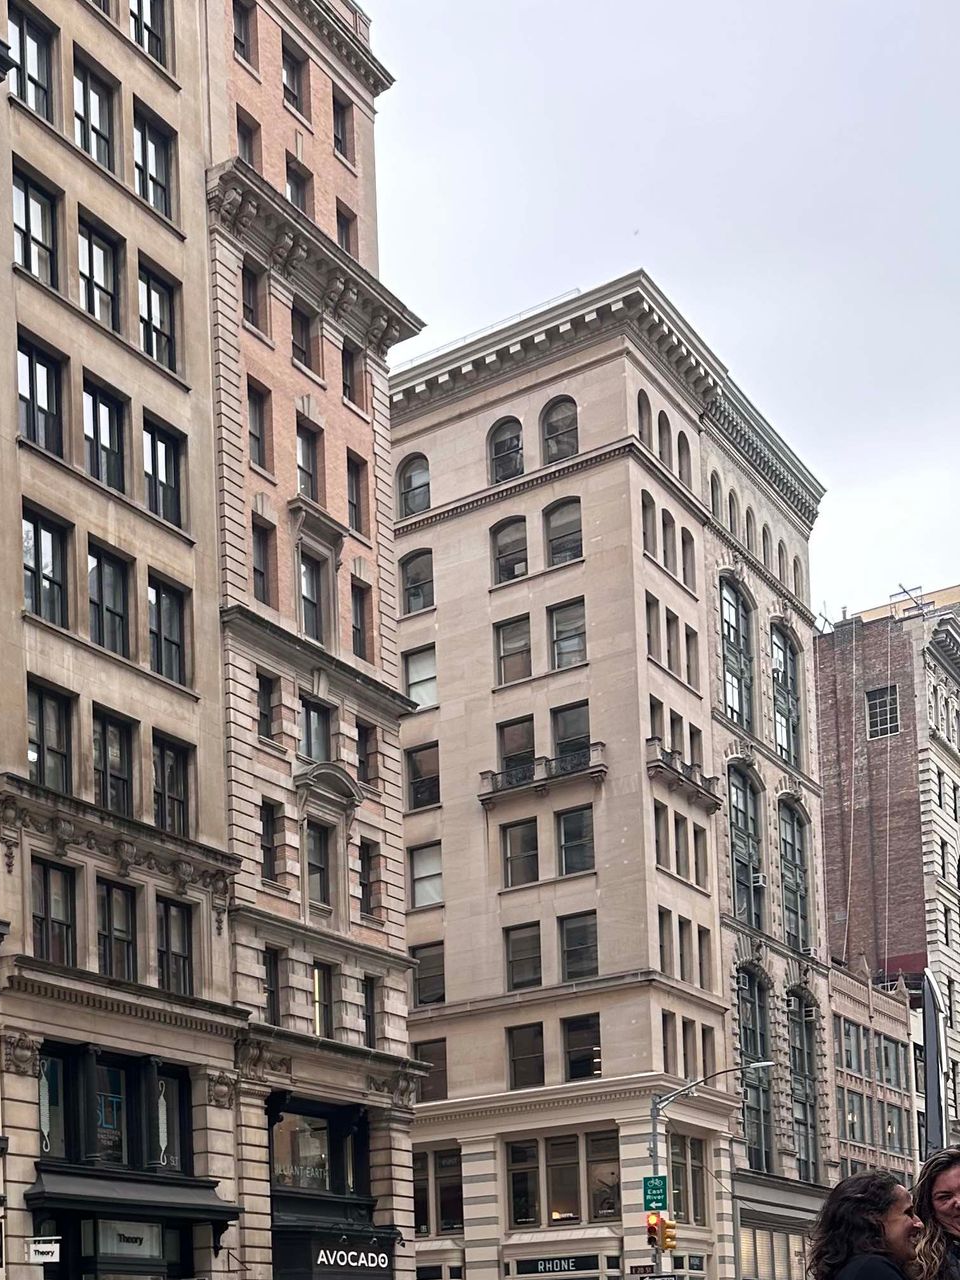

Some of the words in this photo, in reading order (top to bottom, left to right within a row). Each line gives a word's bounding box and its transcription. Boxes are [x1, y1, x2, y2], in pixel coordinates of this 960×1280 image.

[117, 1232, 144, 1247] Theory
[33, 1249, 55, 1258] Theory
[317, 1249, 388, 1268] AVOCADO
[538, 1258, 576, 1273] RHONE
